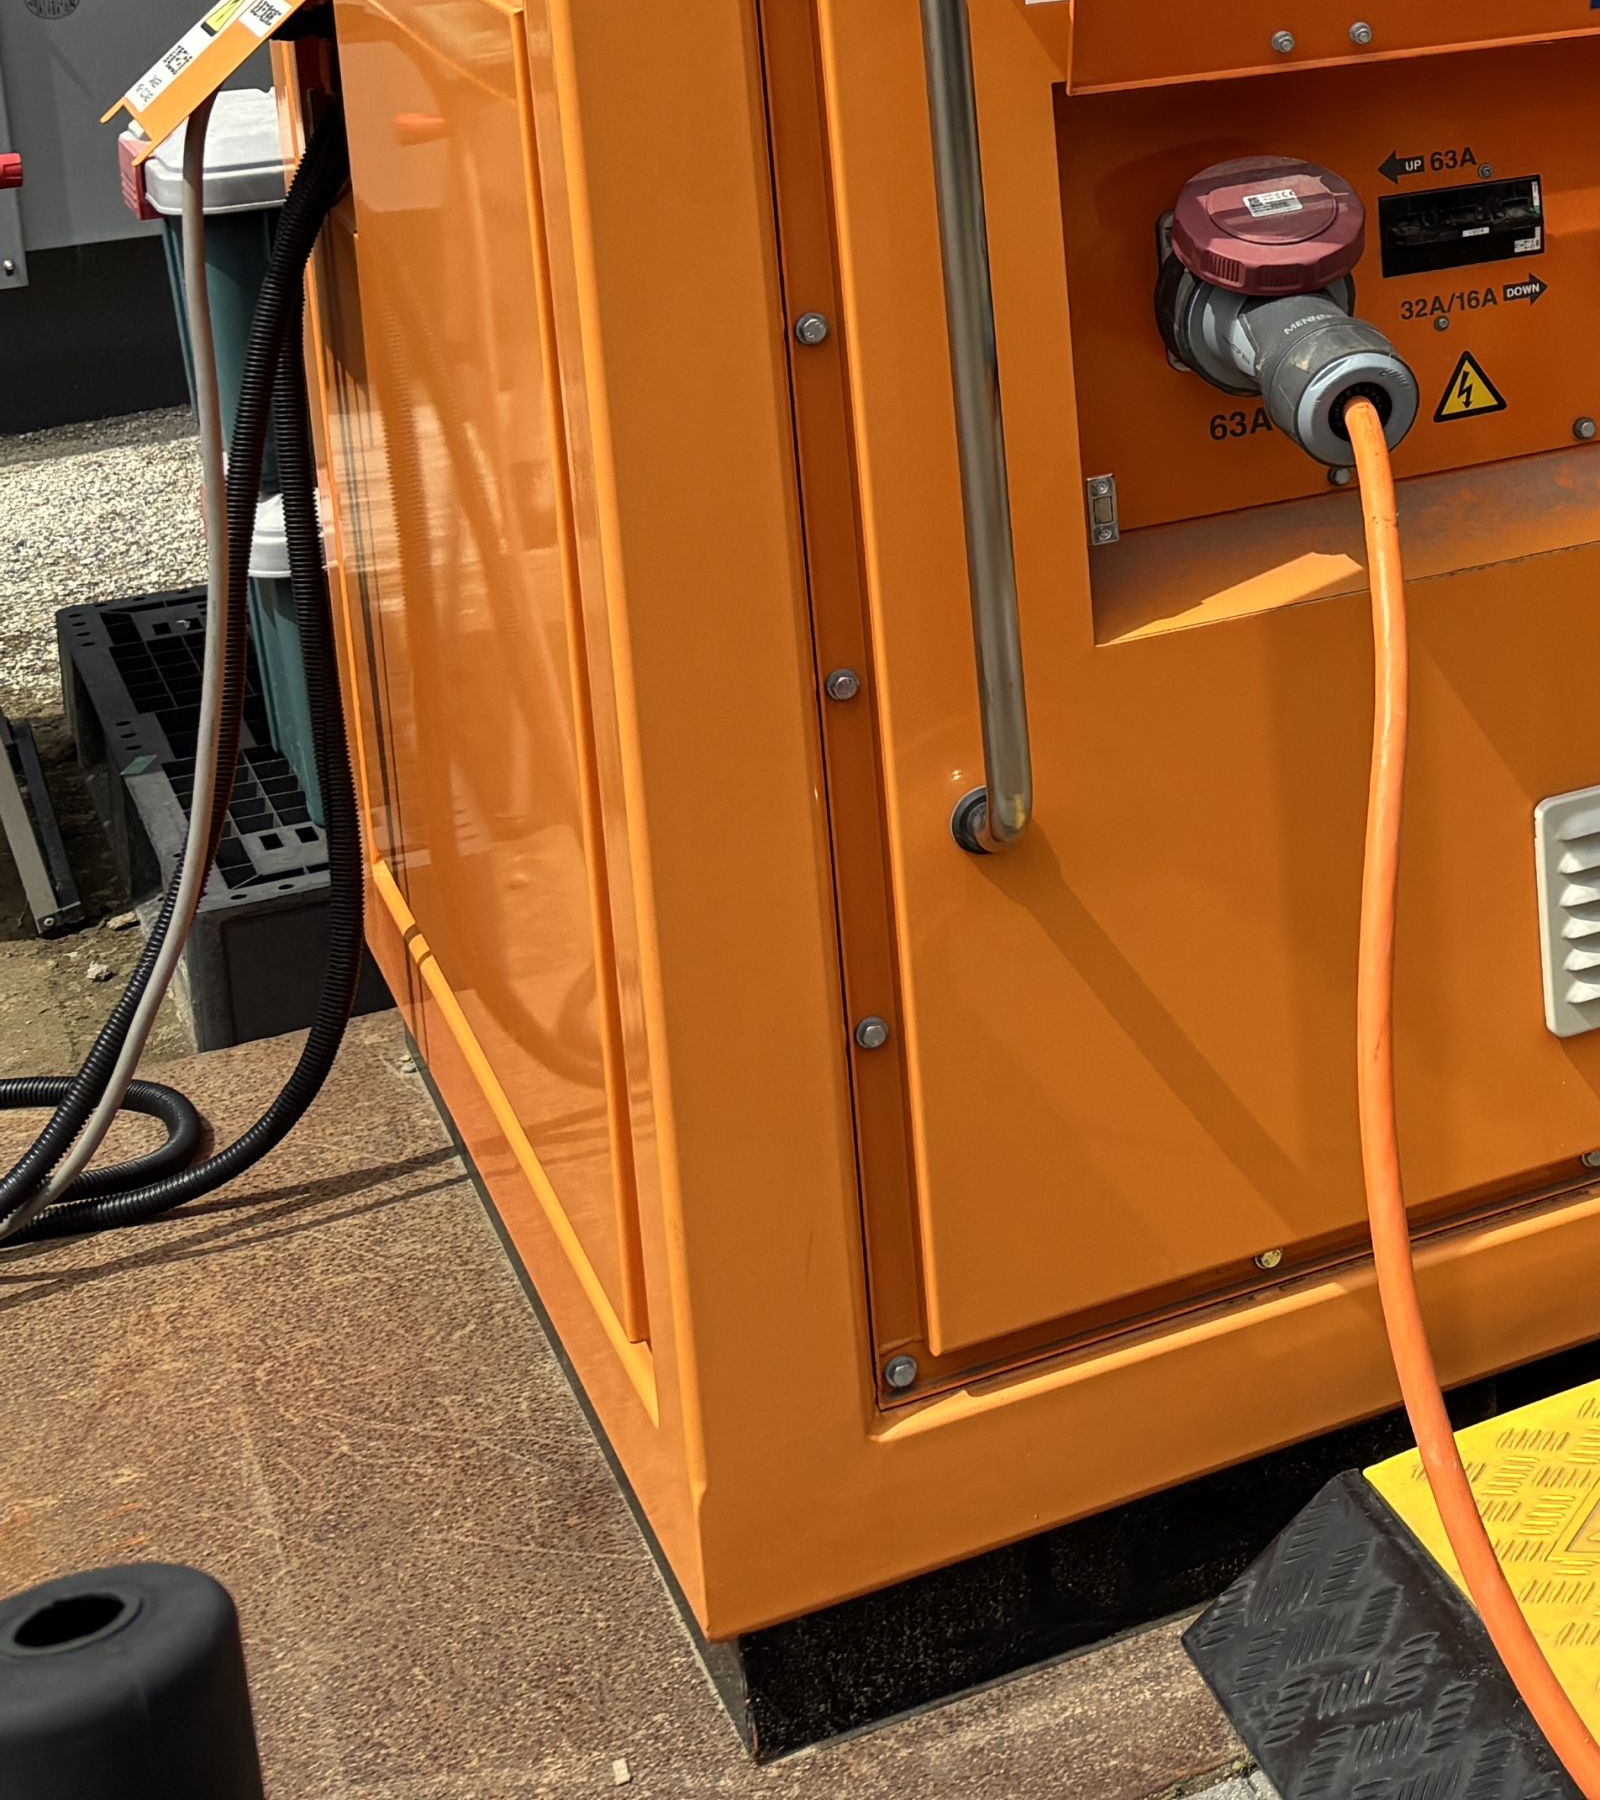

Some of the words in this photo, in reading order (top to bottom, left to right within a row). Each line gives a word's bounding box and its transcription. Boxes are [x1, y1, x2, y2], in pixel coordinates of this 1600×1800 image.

[1405, 159, 1422, 172] UP
[1430, 147, 1477, 172] 63A
[1401, 288, 1498, 320] 32A/16A
[1506, 282, 1540, 297] DOWN
[1209, 406, 1273, 440] 63A
